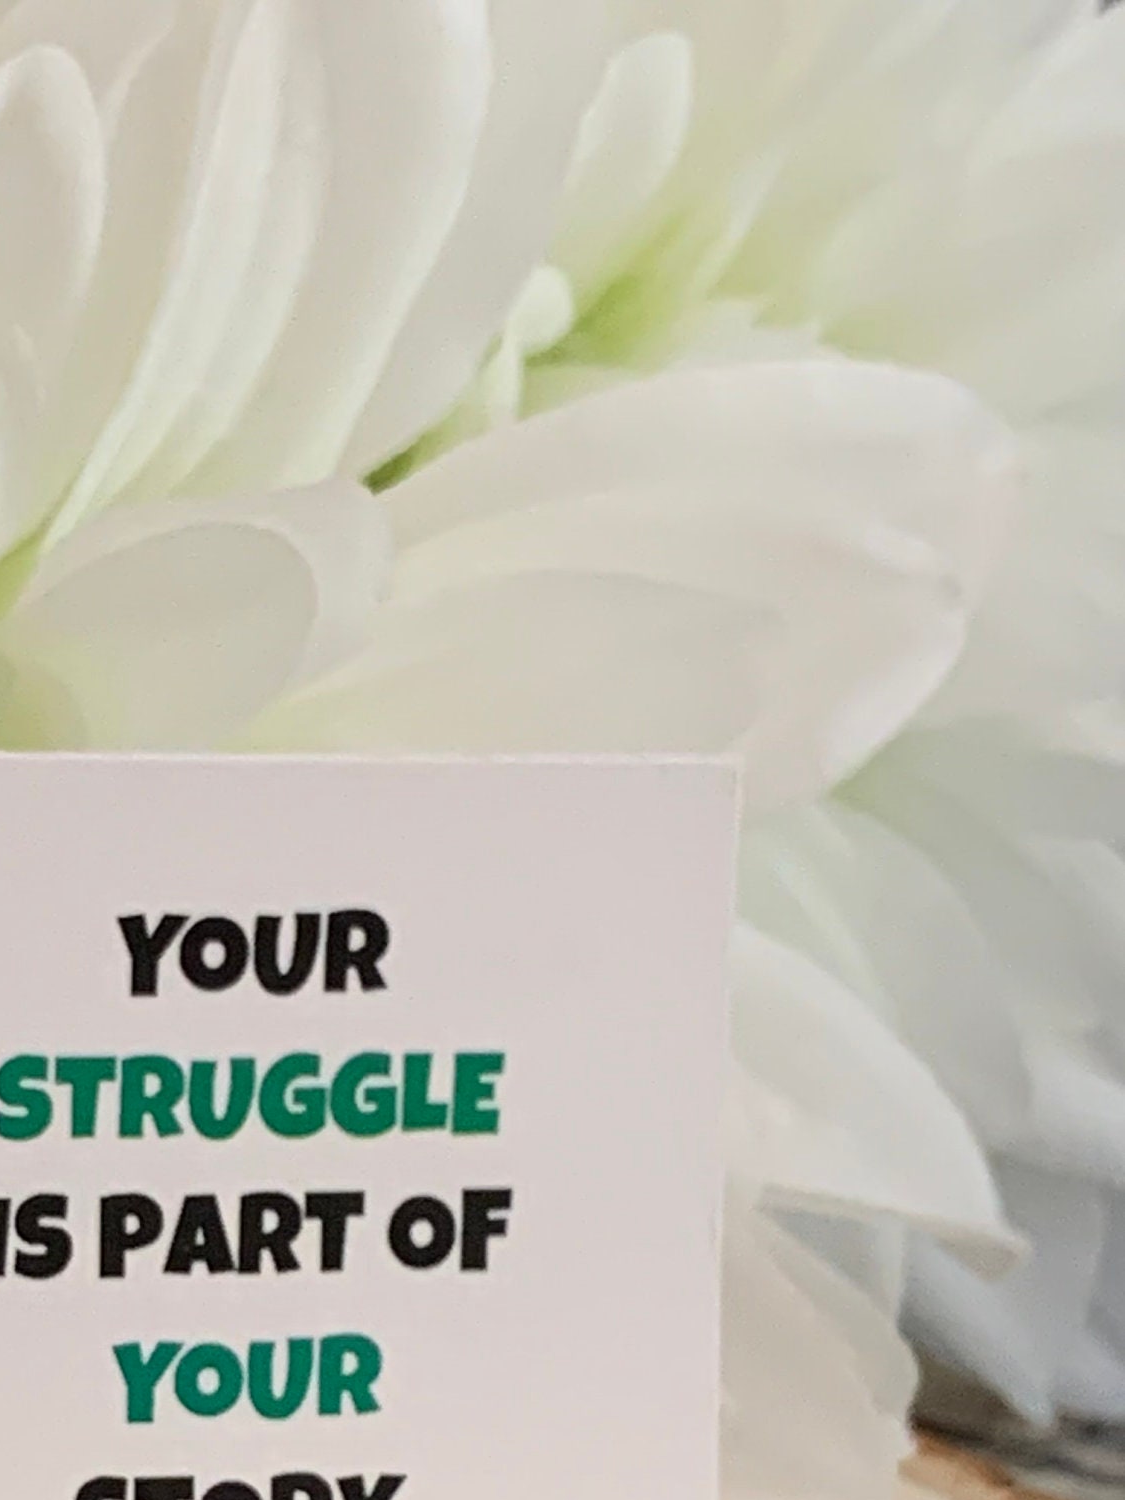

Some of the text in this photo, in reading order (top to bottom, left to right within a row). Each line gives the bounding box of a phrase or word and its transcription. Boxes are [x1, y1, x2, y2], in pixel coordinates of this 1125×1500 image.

[116, 907, 391, 998] YOUR
[97, 1190, 366, 1280] PART
[386, 1187, 514, 1273] OF
[111, 1332, 383, 1425] YOUR
